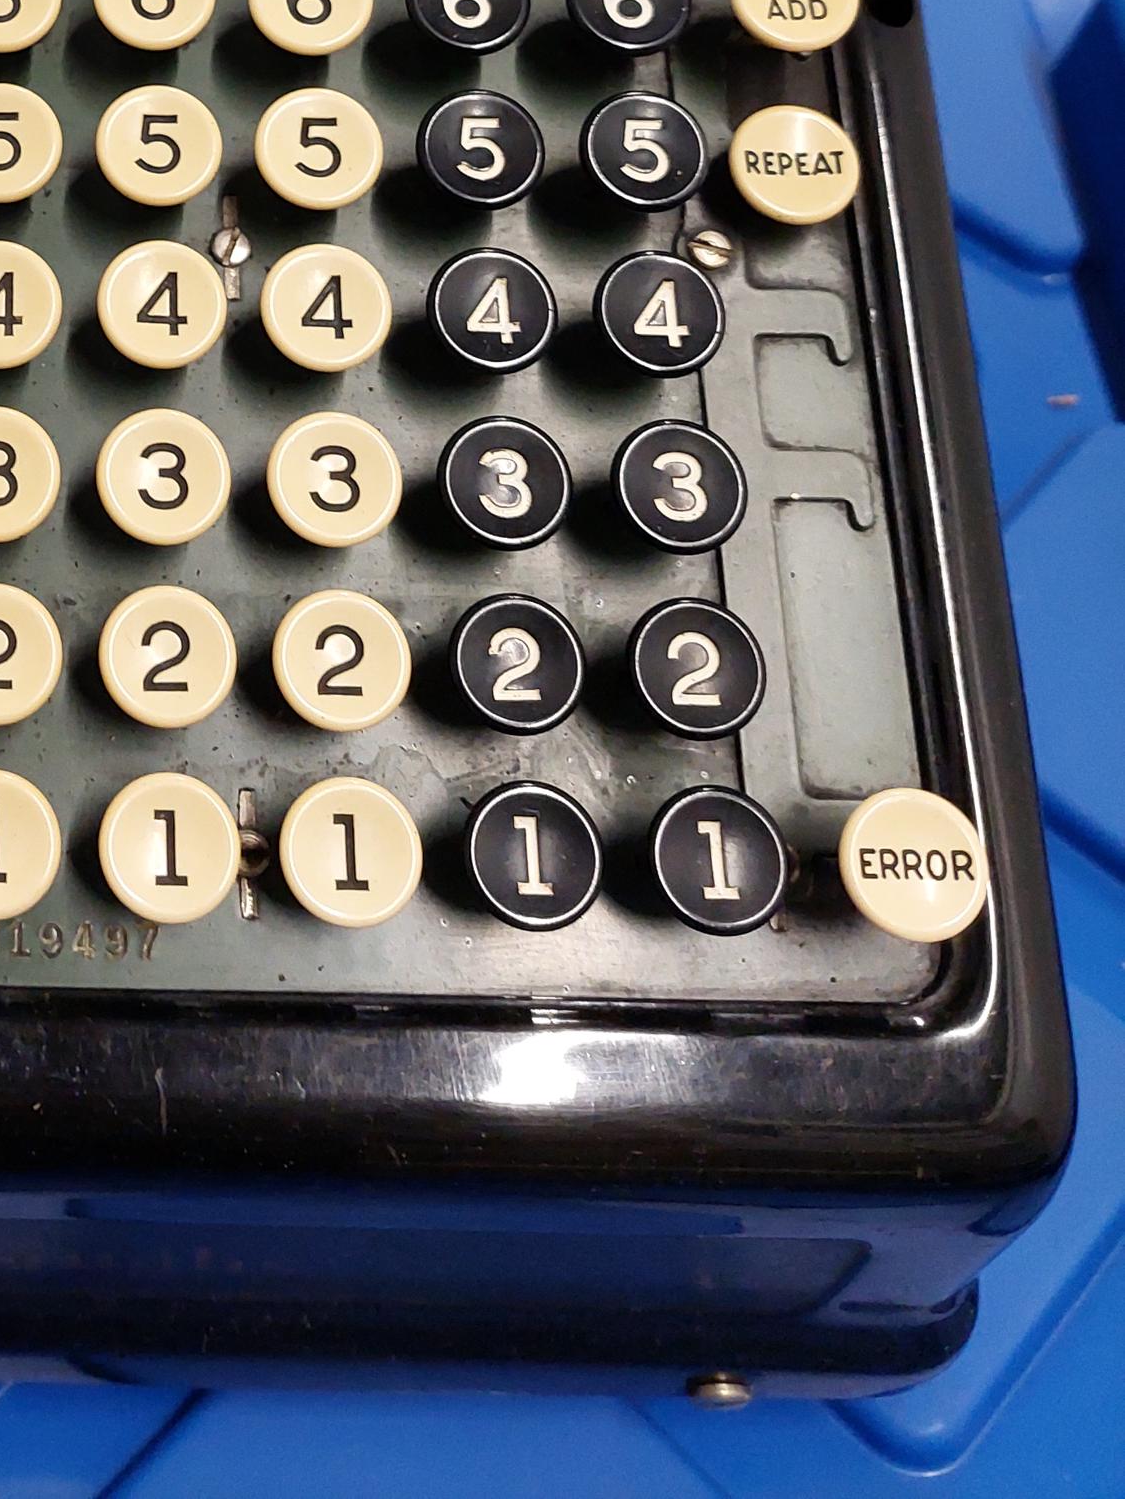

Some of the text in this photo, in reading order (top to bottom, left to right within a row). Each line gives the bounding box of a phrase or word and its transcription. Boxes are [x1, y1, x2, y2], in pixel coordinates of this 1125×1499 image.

[134, 113, 181, 175] 5
[294, 117, 342, 178] 5
[456, 118, 506, 182] 5
[619, 120, 670, 183] 5
[744, 149, 844, 176] REPEAT
[136, 271, 188, 336] 4
[301, 274, 354, 340] 4
[466, 277, 522, 344] 4
[633, 280, 690, 348] 4
[137, 442, 189, 511] 3
[308, 444, 361, 513] 3
[478, 448, 533, 519] 3
[652, 451, 708, 522] 3
[140, 620, 191, 692] 2
[314, 624, 365, 697] 2
[488, 627, 542, 701] 2
[667, 631, 722, 706] 2
[153, 809, 189, 887] 1
[332, 813, 370, 892] 1
[513, 815, 554, 896] 1
[697, 820, 741, 900] 1
[859, 847, 975, 881] ERROR
